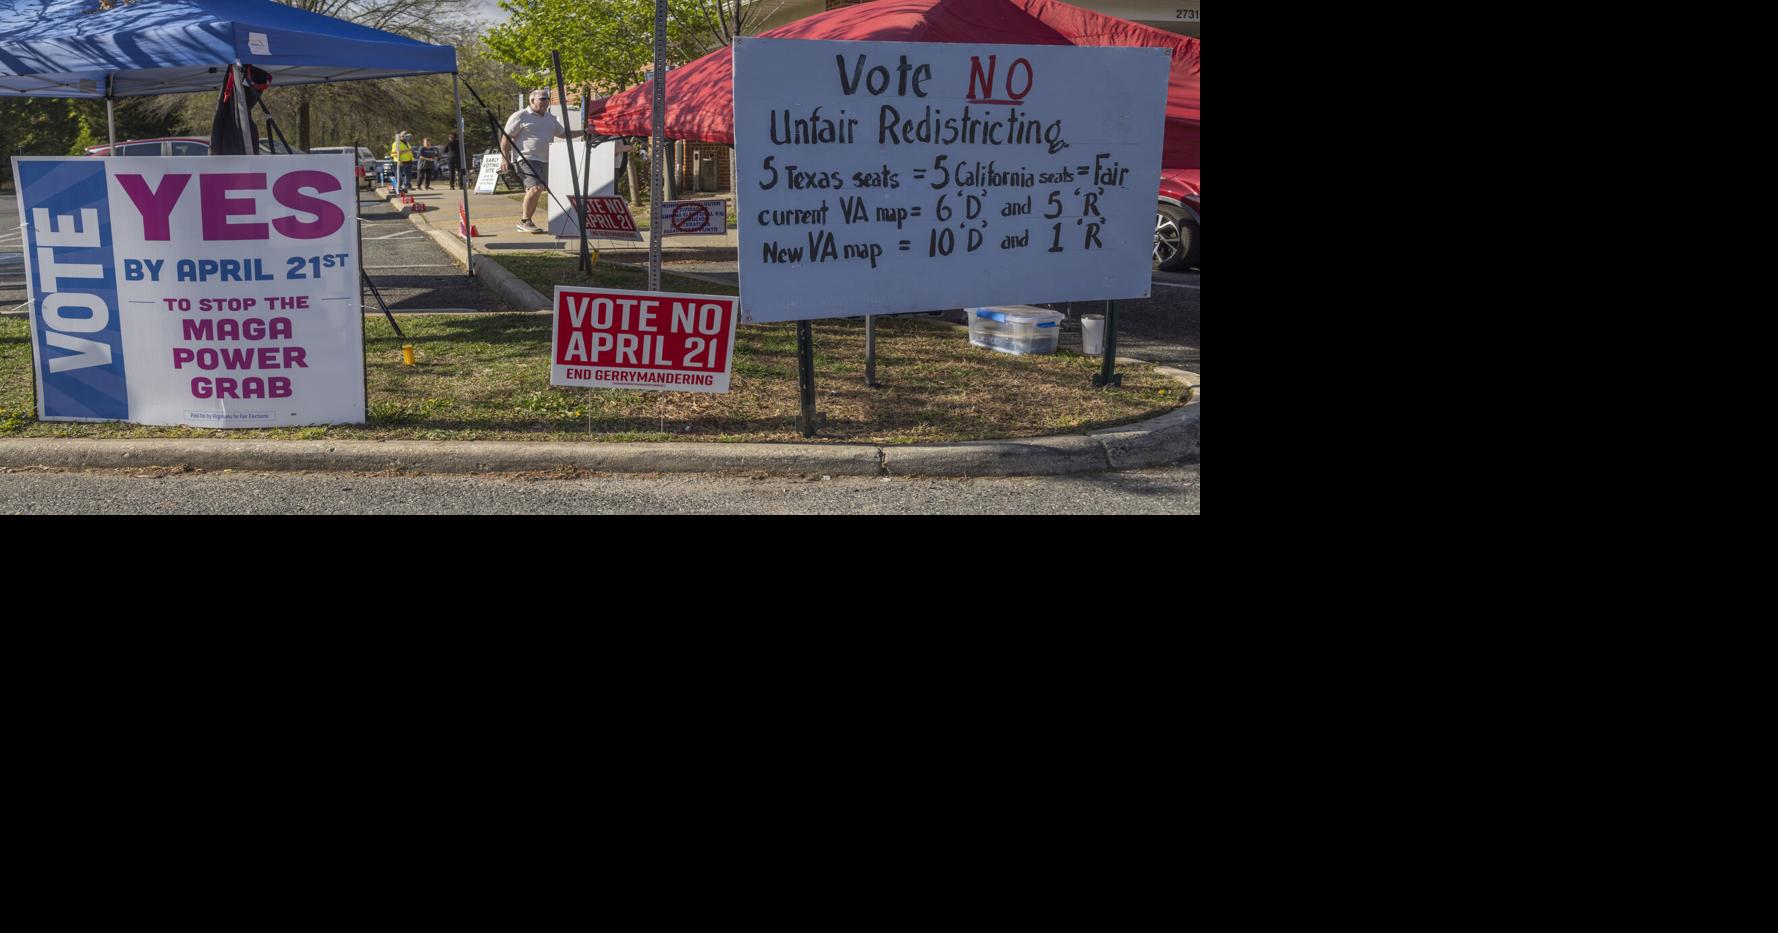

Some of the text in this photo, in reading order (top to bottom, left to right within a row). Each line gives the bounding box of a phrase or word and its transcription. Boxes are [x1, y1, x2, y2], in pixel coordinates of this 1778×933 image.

[1176, 9, 1199, 19] 2731
[836, 54, 1034, 104] Vote NO
[769, 106, 858, 146] Unfair
[759, 156, 779, 190] 5
[785, 165, 844, 189] Texas
[852, 165, 900, 189] seats
[930, 155, 950, 189] 5
[955, 161, 1034, 188] California
[1038, 166, 1075, 183] seats
[1094, 153, 1130, 187] Fair
[114, 170, 346, 242] YES
[605, 199, 625, 214] NO
[616, 214, 633, 229] 21
[758, 200, 829, 226] current
[839, 196, 869, 224] VA
[936, 194, 952, 222] 6
[1001, 195, 1031, 217] and
[1044, 190, 1063, 219] 5
[763, 241, 803, 264] New
[808, 230, 838, 263] VA
[843, 242, 883, 268] map
[929, 227, 955, 258] 10
[1001, 229, 1029, 250] and
[1048, 222, 1064, 252] 1
[124, 253, 349, 282] BY APRIL 21ST
[32, 207, 113, 374] VOTE
[163, 296, 309, 312] TO STOP THE
[182, 317, 293, 341] MAGA
[566, 296, 723, 335] VOTE NO
[172, 346, 309, 370] POWER
[564, 331, 719, 369] APRIL 21
[190, 376, 293, 400] GRAB
[566, 368, 592, 380] END
[595, 370, 713, 386] GERRYMANDERING
